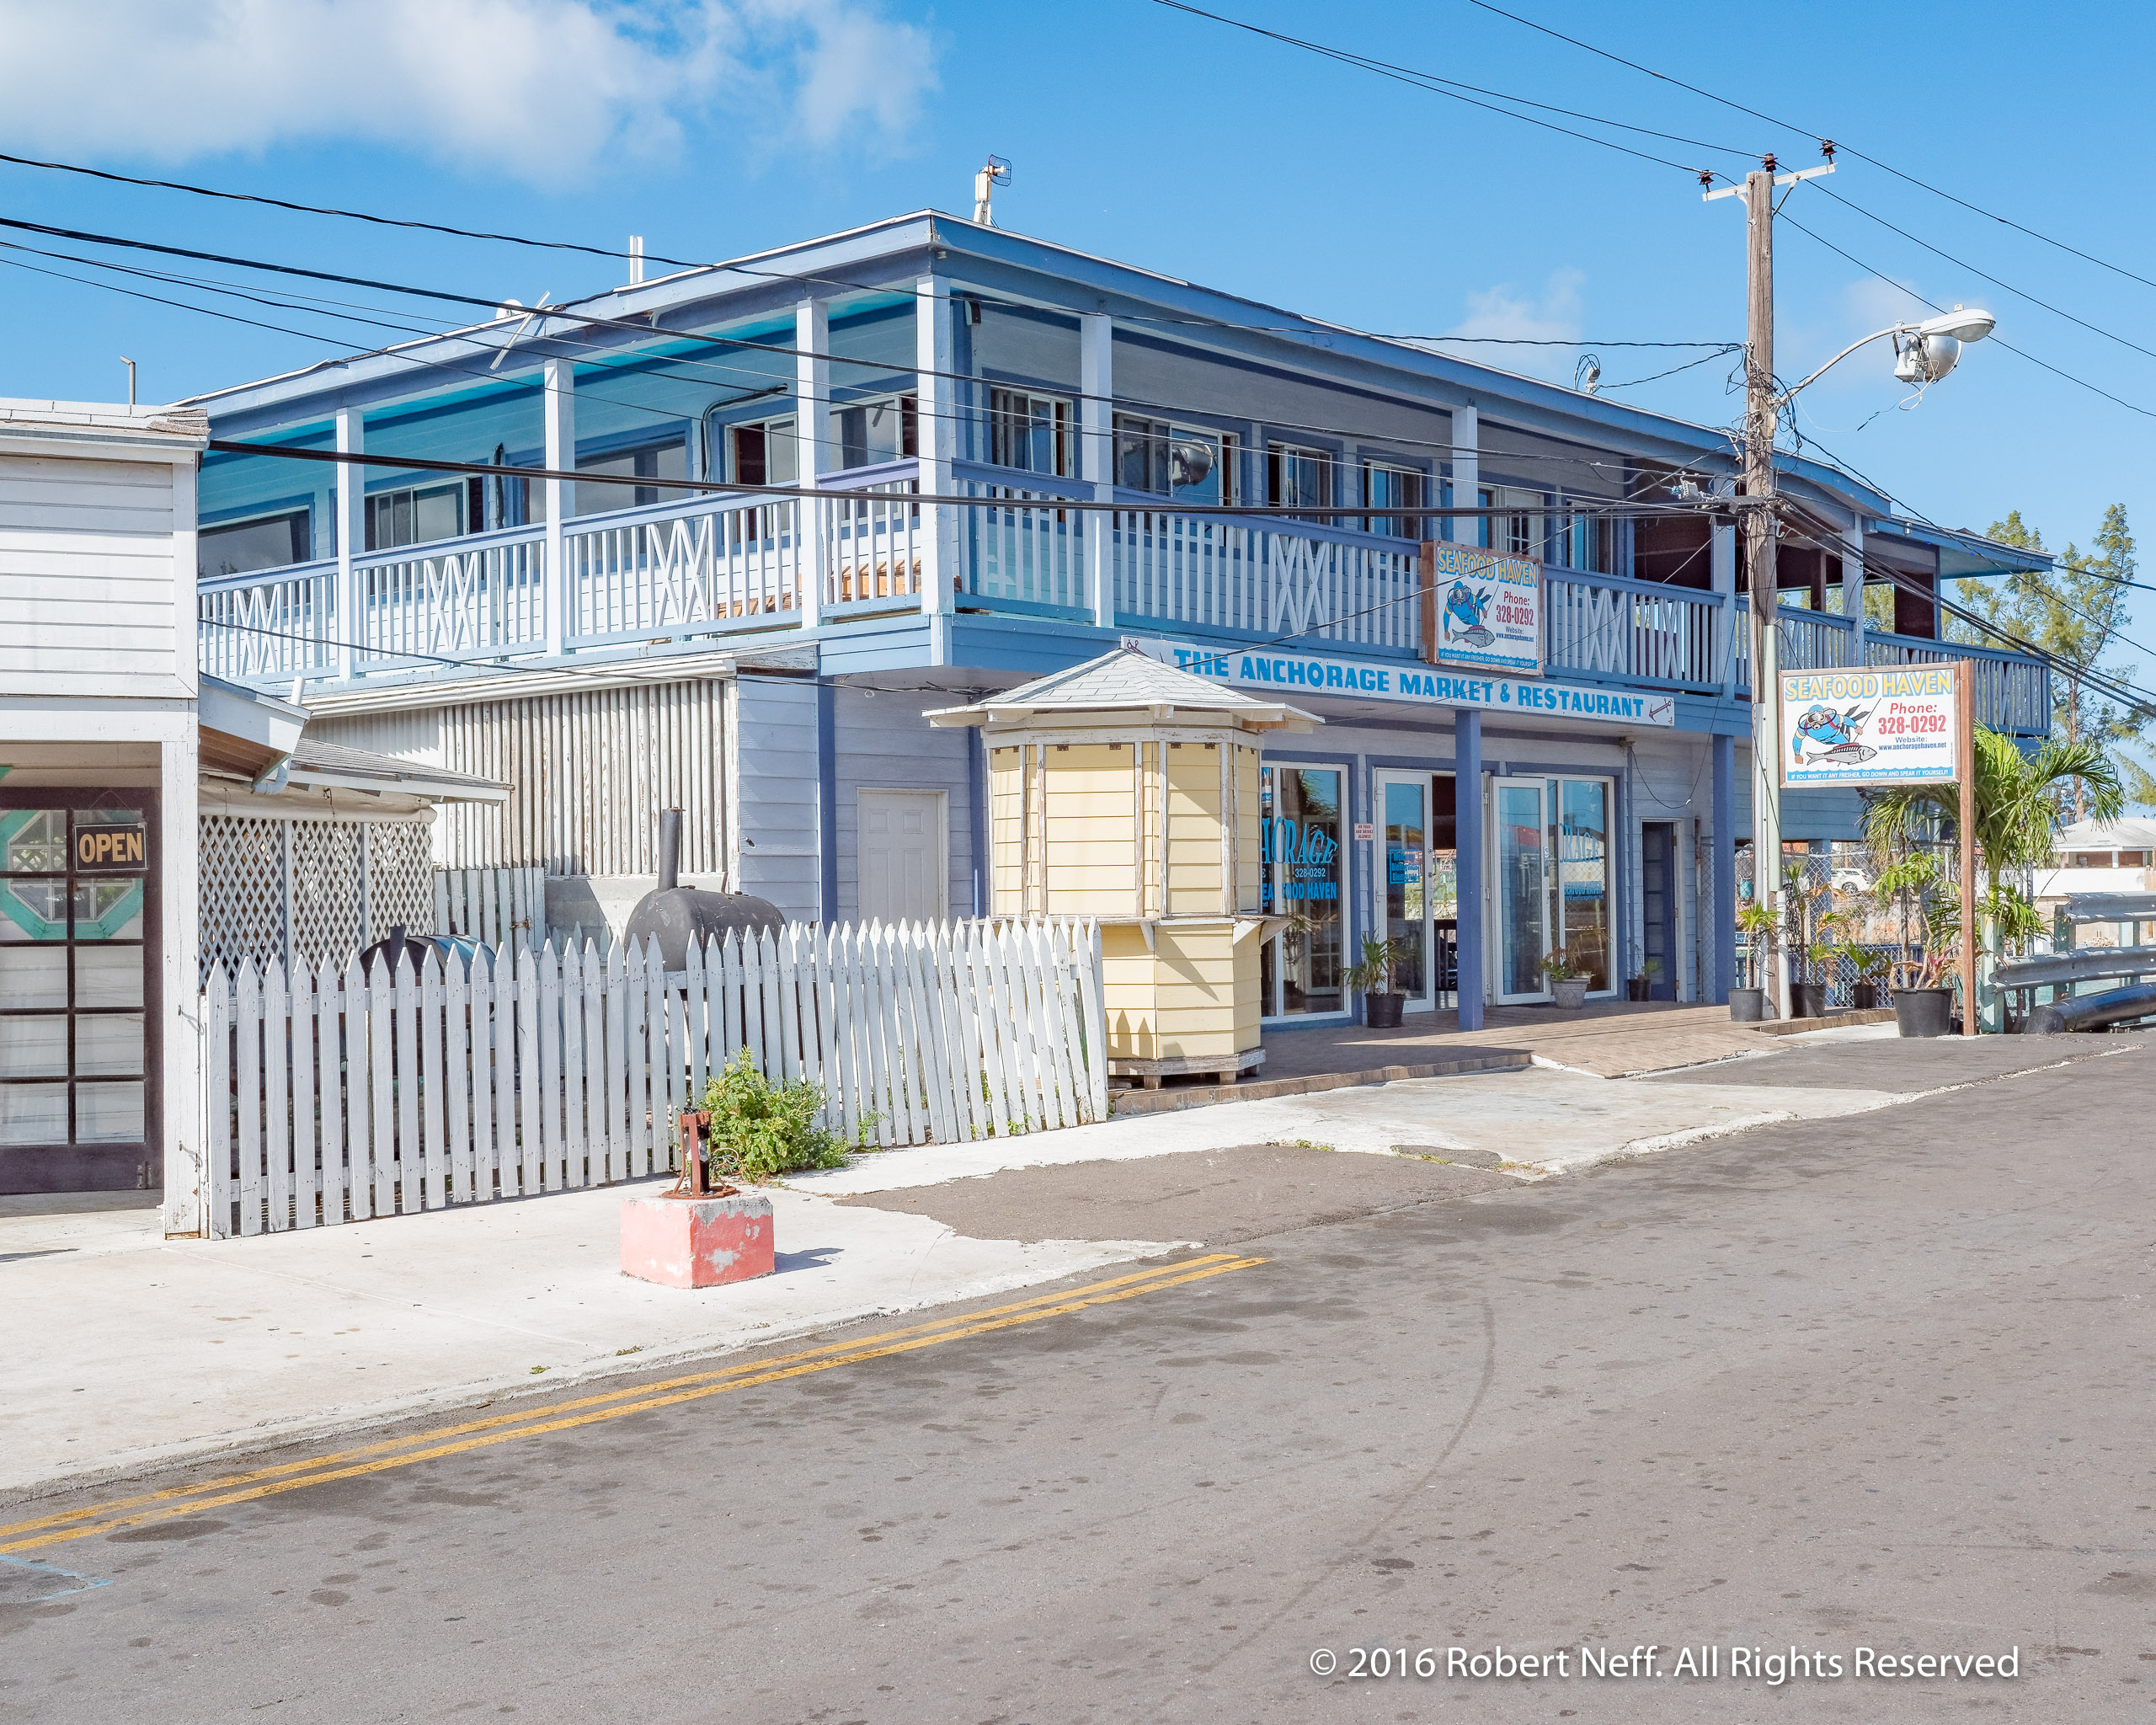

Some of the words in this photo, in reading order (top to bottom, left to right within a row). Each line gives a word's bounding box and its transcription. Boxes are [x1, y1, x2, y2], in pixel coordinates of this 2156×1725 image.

[1438, 547, 1496, 580] SEAFOOD
[1498, 557, 1538, 588] HAVEN
[1504, 591, 1530, 606] Phone:
[1496, 604, 1534, 626] 328-0292
[1506, 626, 1524, 634] Website:
[1173, 649, 1229, 676] THE
[1240, 655, 1390, 692] ANCHORAGE
[1400, 672, 1495, 702] MARKET
[1500, 682, 1511, 703] &
[1518, 685, 1645, 717] RESTAURANT
[1785, 674, 1879, 702] SEAFOOD
[1882, 670, 1953, 697] HAVEN
[1890, 702, 1937, 714] Phone:
[1878, 714, 1946, 734] 328-0292
[1878, 742, 1946, 750] www.anchoragehaven.net
[79, 832, 143, 863] OPEN
[1295, 868, 1326, 878] 328-0292
[1307, 882, 1337, 900] HAVEN
